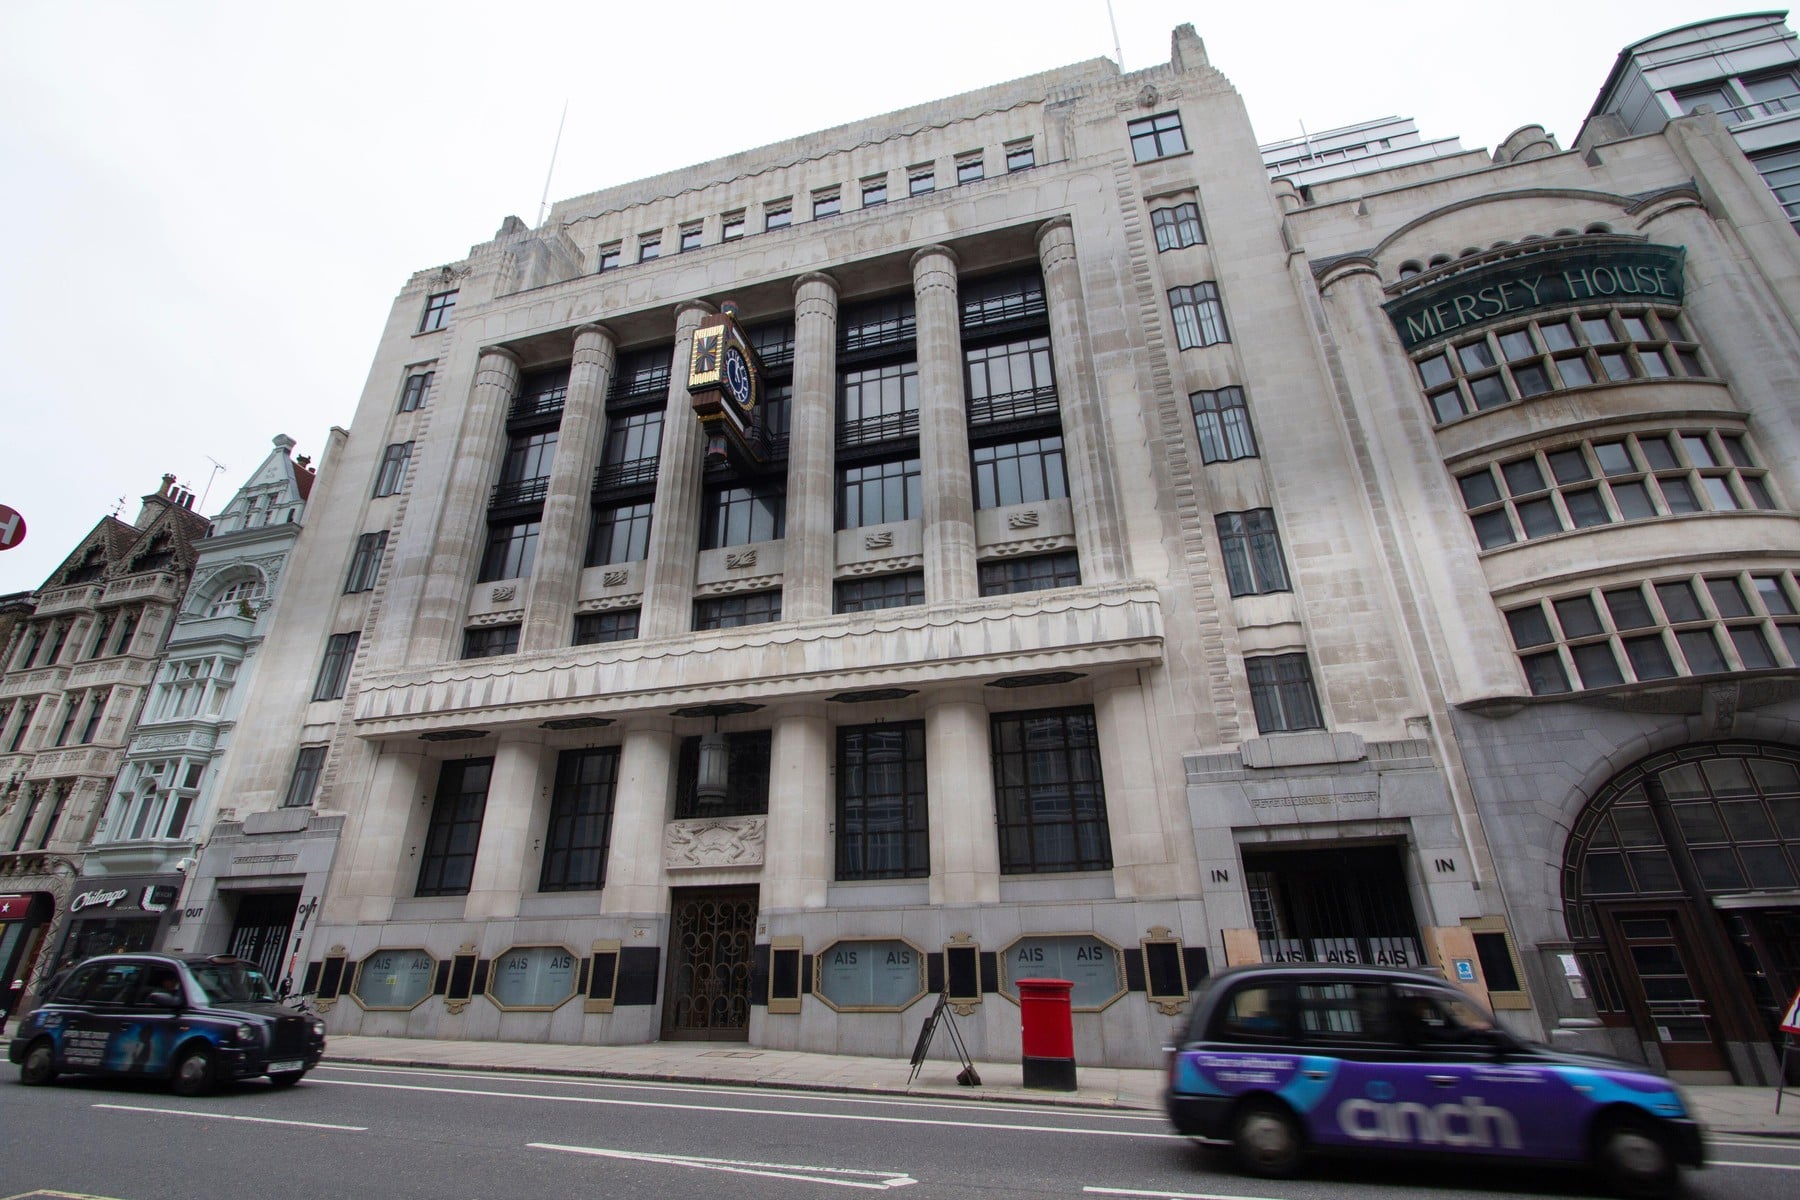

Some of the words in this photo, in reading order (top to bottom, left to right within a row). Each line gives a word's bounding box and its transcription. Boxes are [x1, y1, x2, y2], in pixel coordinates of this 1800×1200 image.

[1406, 274, 1544, 343] MERSEY
[1562, 265, 1676, 299] HOUSE
[1434, 858, 1456, 873] IN
[1211, 869, 1229, 883] IN
[70, 888, 128, 912] Chilango
[185, 907, 203, 918] OUT
[834, 951, 857, 965] AIS
[886, 951, 910, 965] AIS
[1018, 947, 1044, 962] AIS
[1077, 946, 1103, 961] AIS
[1275, 950, 1304, 963] AIS
[1327, 949, 1357, 964] AIS
[1376, 949, 1407, 965] AIS
[373, 958, 391, 970] AIS
[411, 958, 430, 970] AIS
[508, 958, 528, 970] AIS
[550, 956, 571, 969] AIS
